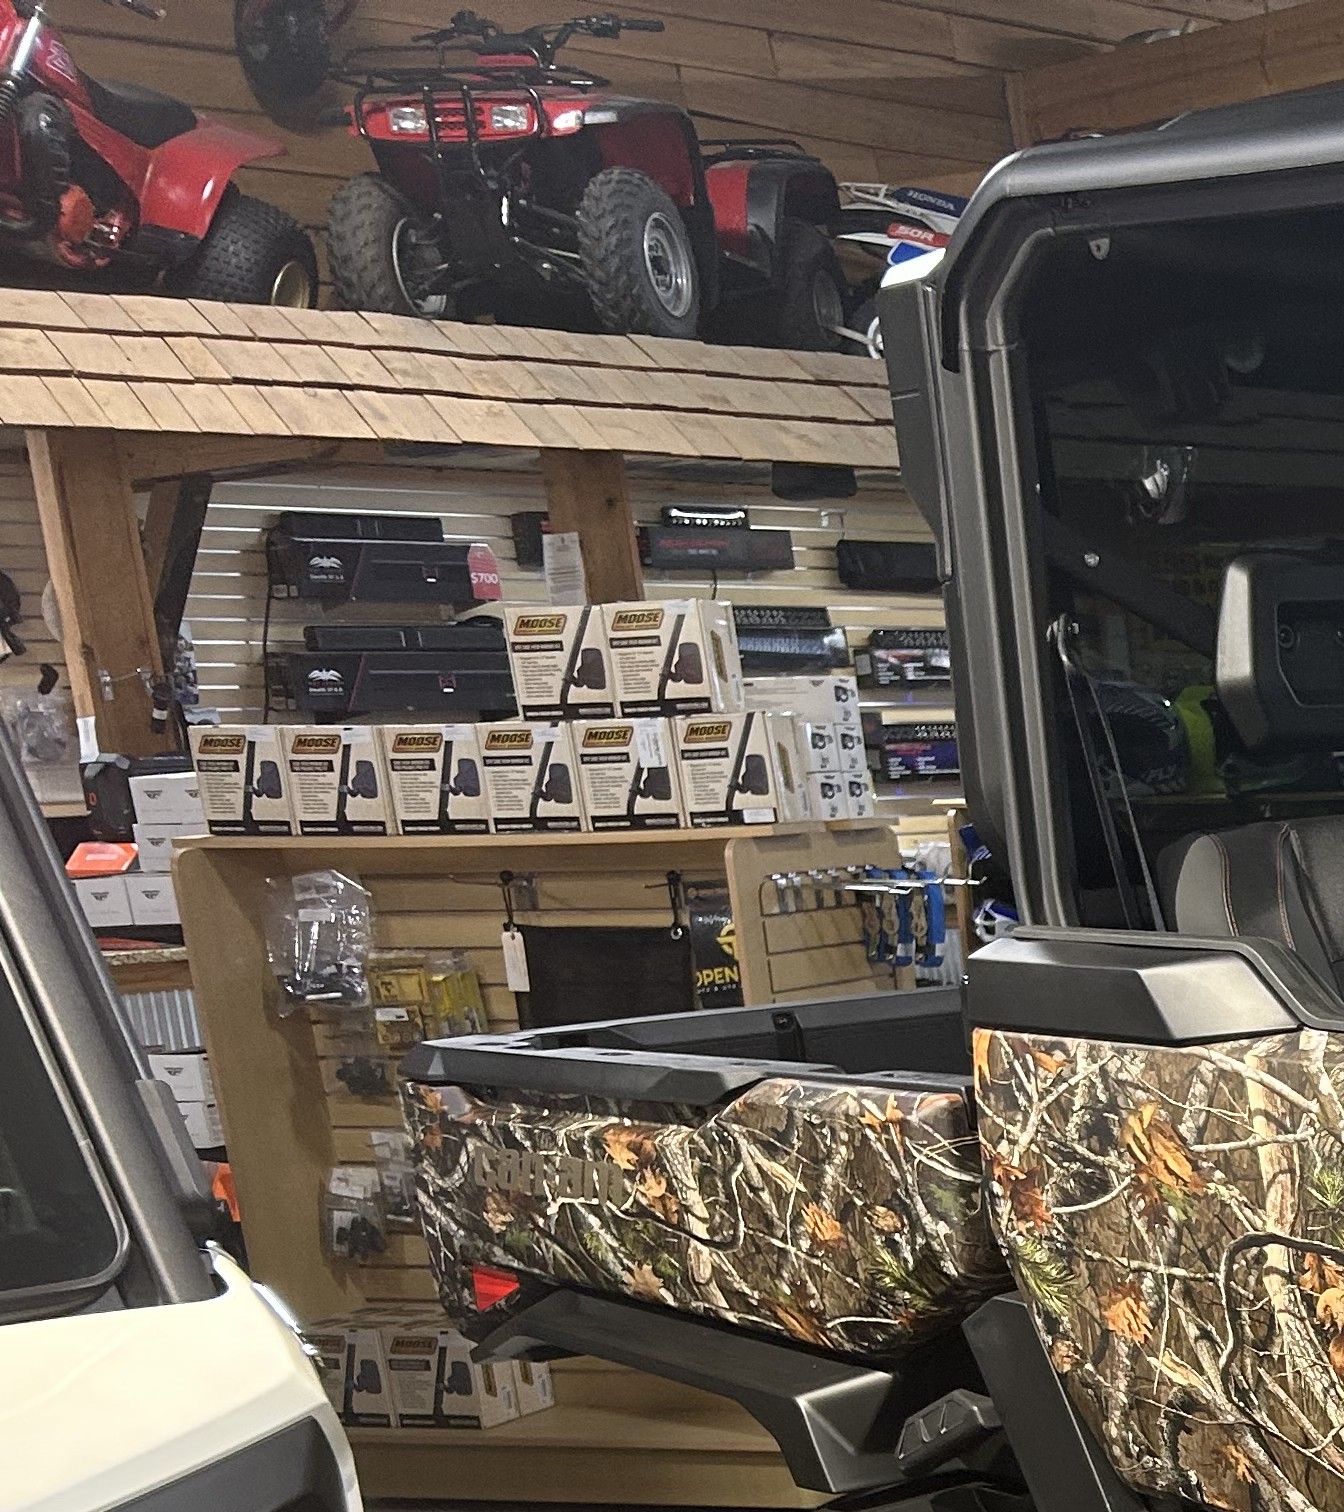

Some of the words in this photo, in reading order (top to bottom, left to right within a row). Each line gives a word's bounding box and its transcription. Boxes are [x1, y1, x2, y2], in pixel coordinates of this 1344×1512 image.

[907, 189, 956, 212] HONDA
[518, 618, 564, 630] MOOSE
[615, 613, 661, 625] MOOSE
[586, 729, 629, 742] MOOSE
[688, 725, 728, 738] MOOSE
[203, 737, 243, 749] MOOSE
[296, 737, 338, 749] MOOSE
[396, 736, 439, 748] MOOSE
[489, 732, 533, 744] MOOSE
[474, 1145, 625, 1207] can-am
